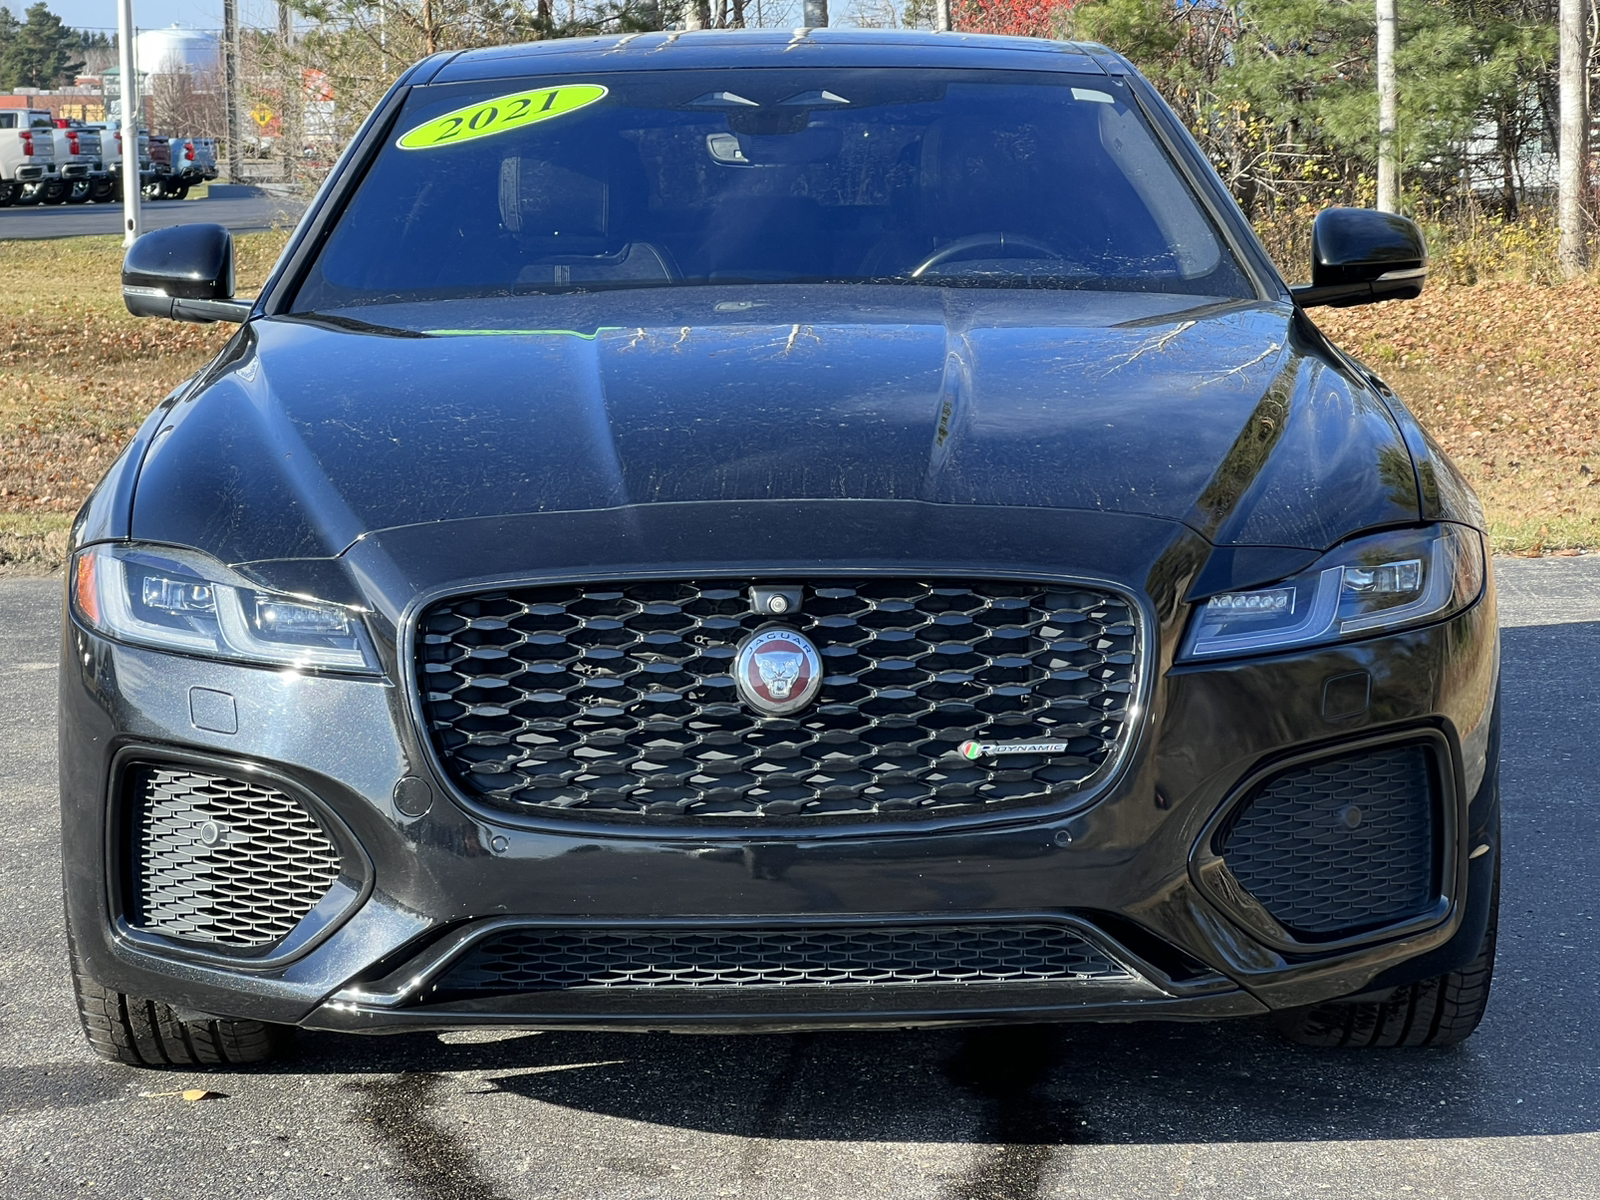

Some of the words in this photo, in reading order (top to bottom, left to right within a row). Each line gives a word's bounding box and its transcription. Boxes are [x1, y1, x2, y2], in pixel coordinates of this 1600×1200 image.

[432, 90, 560, 143] 2021
[748, 633, 811, 654] JAGUAR
[996, 743, 1064, 752] DYNAMIC
